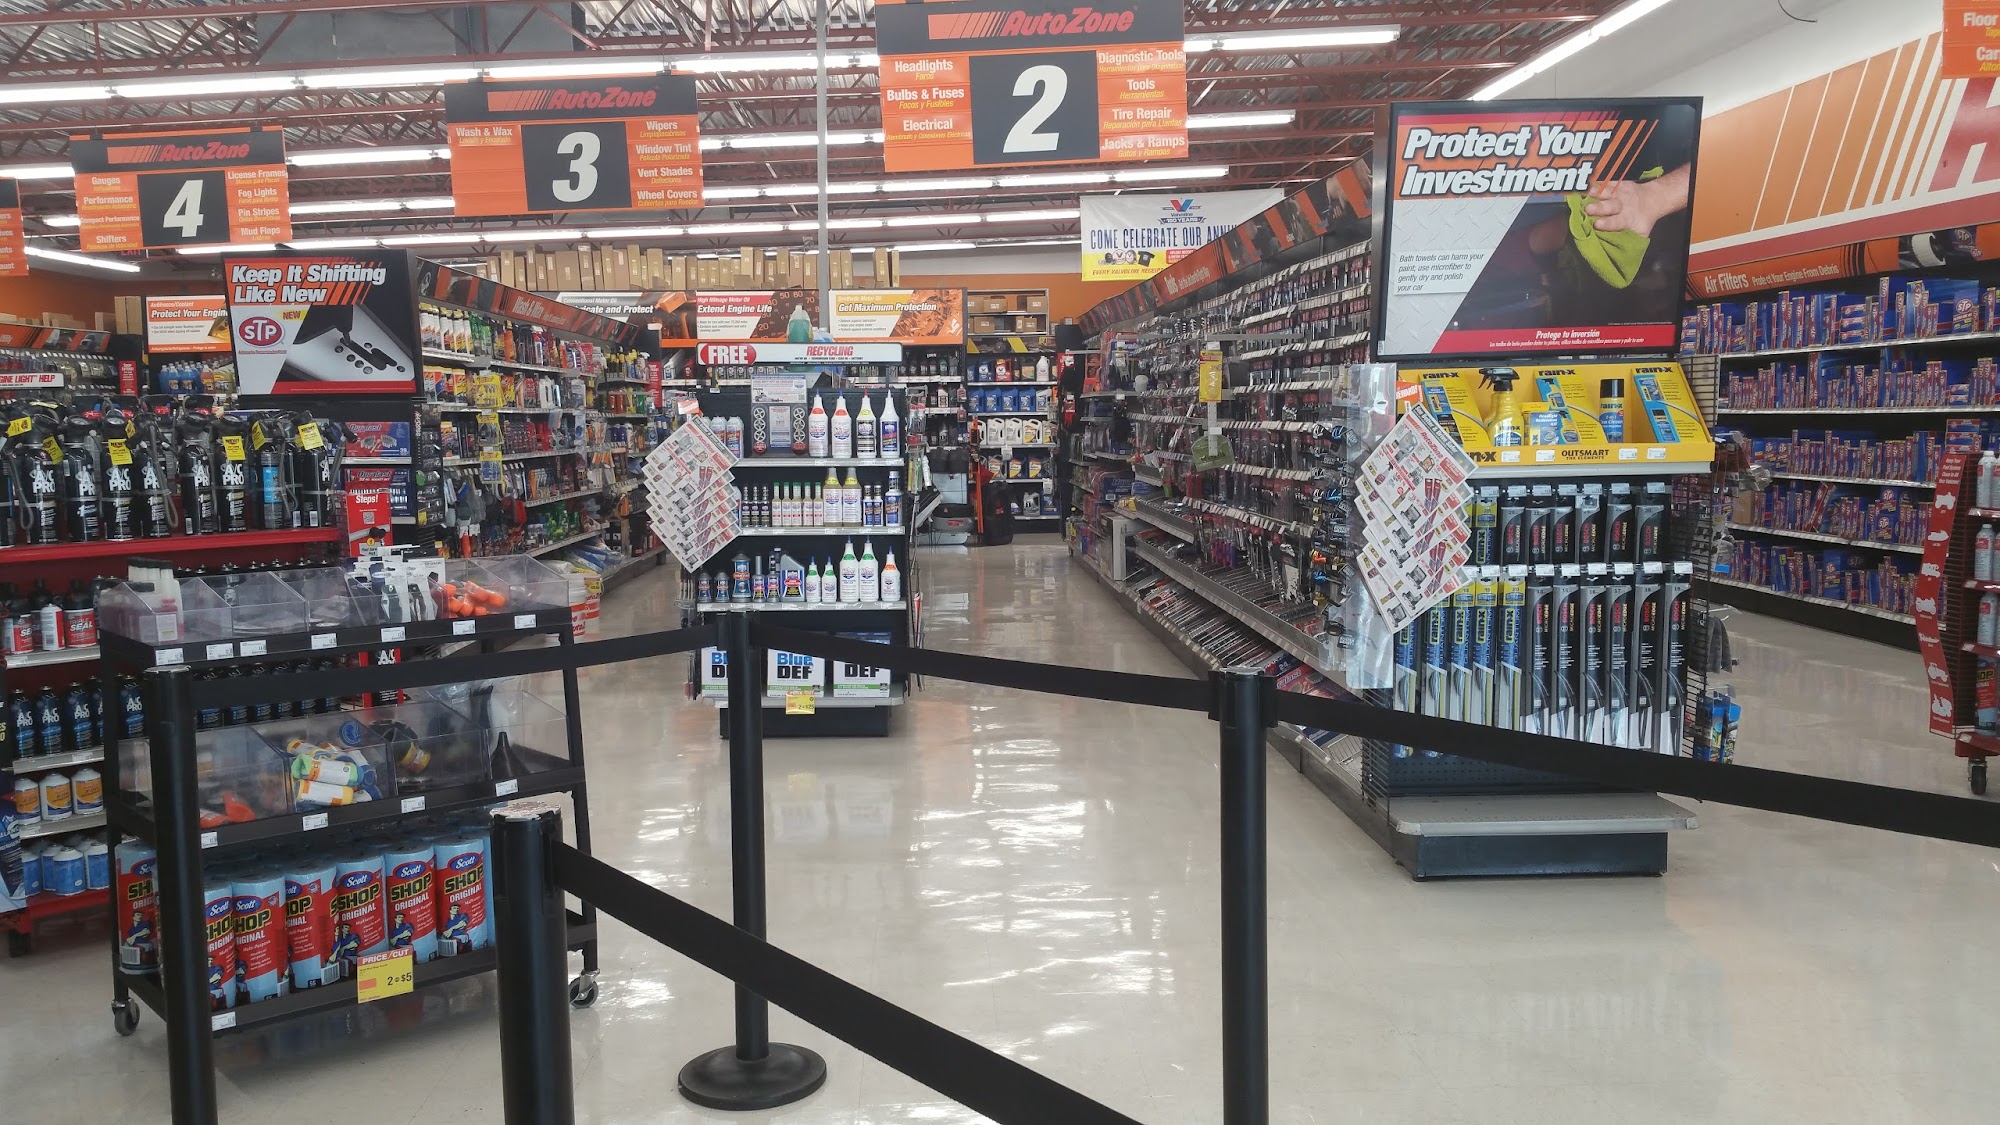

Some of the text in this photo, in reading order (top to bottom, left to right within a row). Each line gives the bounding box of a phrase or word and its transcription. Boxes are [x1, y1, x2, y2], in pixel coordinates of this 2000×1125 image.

[1000, 7, 1134, 36] AutoZone
[1964, 12, 1999, 26] Floor
[1098, 49, 1184, 65] Diagnostic Tools
[895, 59, 953, 72] Headlights
[916, 72, 934, 80] Faros
[1127, 78, 1155, 90] Tools
[550, 87, 656, 109] AutoZone
[887, 88, 964, 100] Bulbs & Fuses
[1120, 90, 1164, 100] Herramientas
[899, 99, 954, 110] Focos y Fusibles
[1003, 64, 1067, 153] 2
[1112, 107, 1172, 121] Tire Repair
[646, 120, 678, 132] Wipers
[903, 118, 953, 132] Electrical
[1104, 121, 1140, 130] Reparación
[1158, 119, 1182, 128] Llantas
[456, 127, 512, 137] Wash & Wax
[636, 144, 692, 154] Window Tint
[1102, 136, 1185, 150] Jacks & Ramps
[1403, 126, 1612, 159] Protect Your
[159, 142, 250, 162] AutoZone
[1118, 149, 1136, 158] Gatos
[1144, 148, 1170, 156] Rampas
[552, 132, 600, 202] 3
[638, 167, 694, 178] Vent Shades
[92, 176, 120, 185] Gauges
[228, 170, 286, 180] License Frames
[1400, 162, 1592, 196] Investment
[238, 188, 278, 198] Fog Lights
[637, 190, 698, 200] Wheel Covers
[83, 196, 134, 205] Performance
[162, 180, 204, 238] 4
[238, 208, 280, 217] Pin Stripes
[241, 226, 280, 236] Mud Flaps
[96, 235, 126, 243] Shifters
[1090, 230, 1118, 250] COME
[1124, 228, 1178, 249] CELEBRATE
[1183, 226, 1202, 246] OUR
[1400, 254, 1414, 262] Bath
[1416, 254, 1437, 262] towels
[1469, 254, 1484, 262] your
[1430, 263, 1464, 271] microfiber
[232, 264, 386, 285] Keep It Shifting
[1398, 274, 1418, 283] gently
[1418, 274, 1430, 282] dry
[1444, 273, 1464, 281] polish
[1772, 274, 1784, 284] Your
[1784, 270, 1804, 282] Engine
[1803, 268, 1819, 278] From
[1819, 264, 1840, 276] Debris
[1704, 272, 1750, 293] Air Filters
[234, 285, 327, 303] Like New
[604, 304, 654, 314] and Protect
[698, 304, 772, 314] Extend Engine Life
[838, 303, 937, 312] Get Maximum Protection
[1958, 300, 1971, 311] STP
[152, 310, 181, 318] Protect
[183, 309, 200, 318] Your
[282, 311, 301, 320] NEW
[244, 320, 278, 342] STP
[1536, 330, 1600, 340] Protege tu inversión
[708, 345, 854, 364] FREE RECYCLING
[38, 374, 56, 382] HELP
[1420, 432, 1444, 458] AutoZone
[110, 467, 130, 482] A/C
[109, 480, 132, 492] PRO
[356, 494, 378, 504] Steps!
[70, 622, 93, 632] SEAL
[777, 652, 813, 666] Blue
[777, 666, 812, 680] DEF
[844, 664, 880, 678] DEF
[456, 854, 476, 869] Scott
[400, 864, 422, 878] Scott
[346, 875, 368, 888] Scott
[444, 864, 484, 894] SHOP
[390, 872, 432, 902] SHOP
[338, 882, 380, 915] SHOP
[394, 892, 430, 912] ORIGINAL
[342, 902, 376, 922] ORIGINAL
[362, 948, 409, 964] PRICE/CUT
[388, 972, 412, 986] 2 $5
